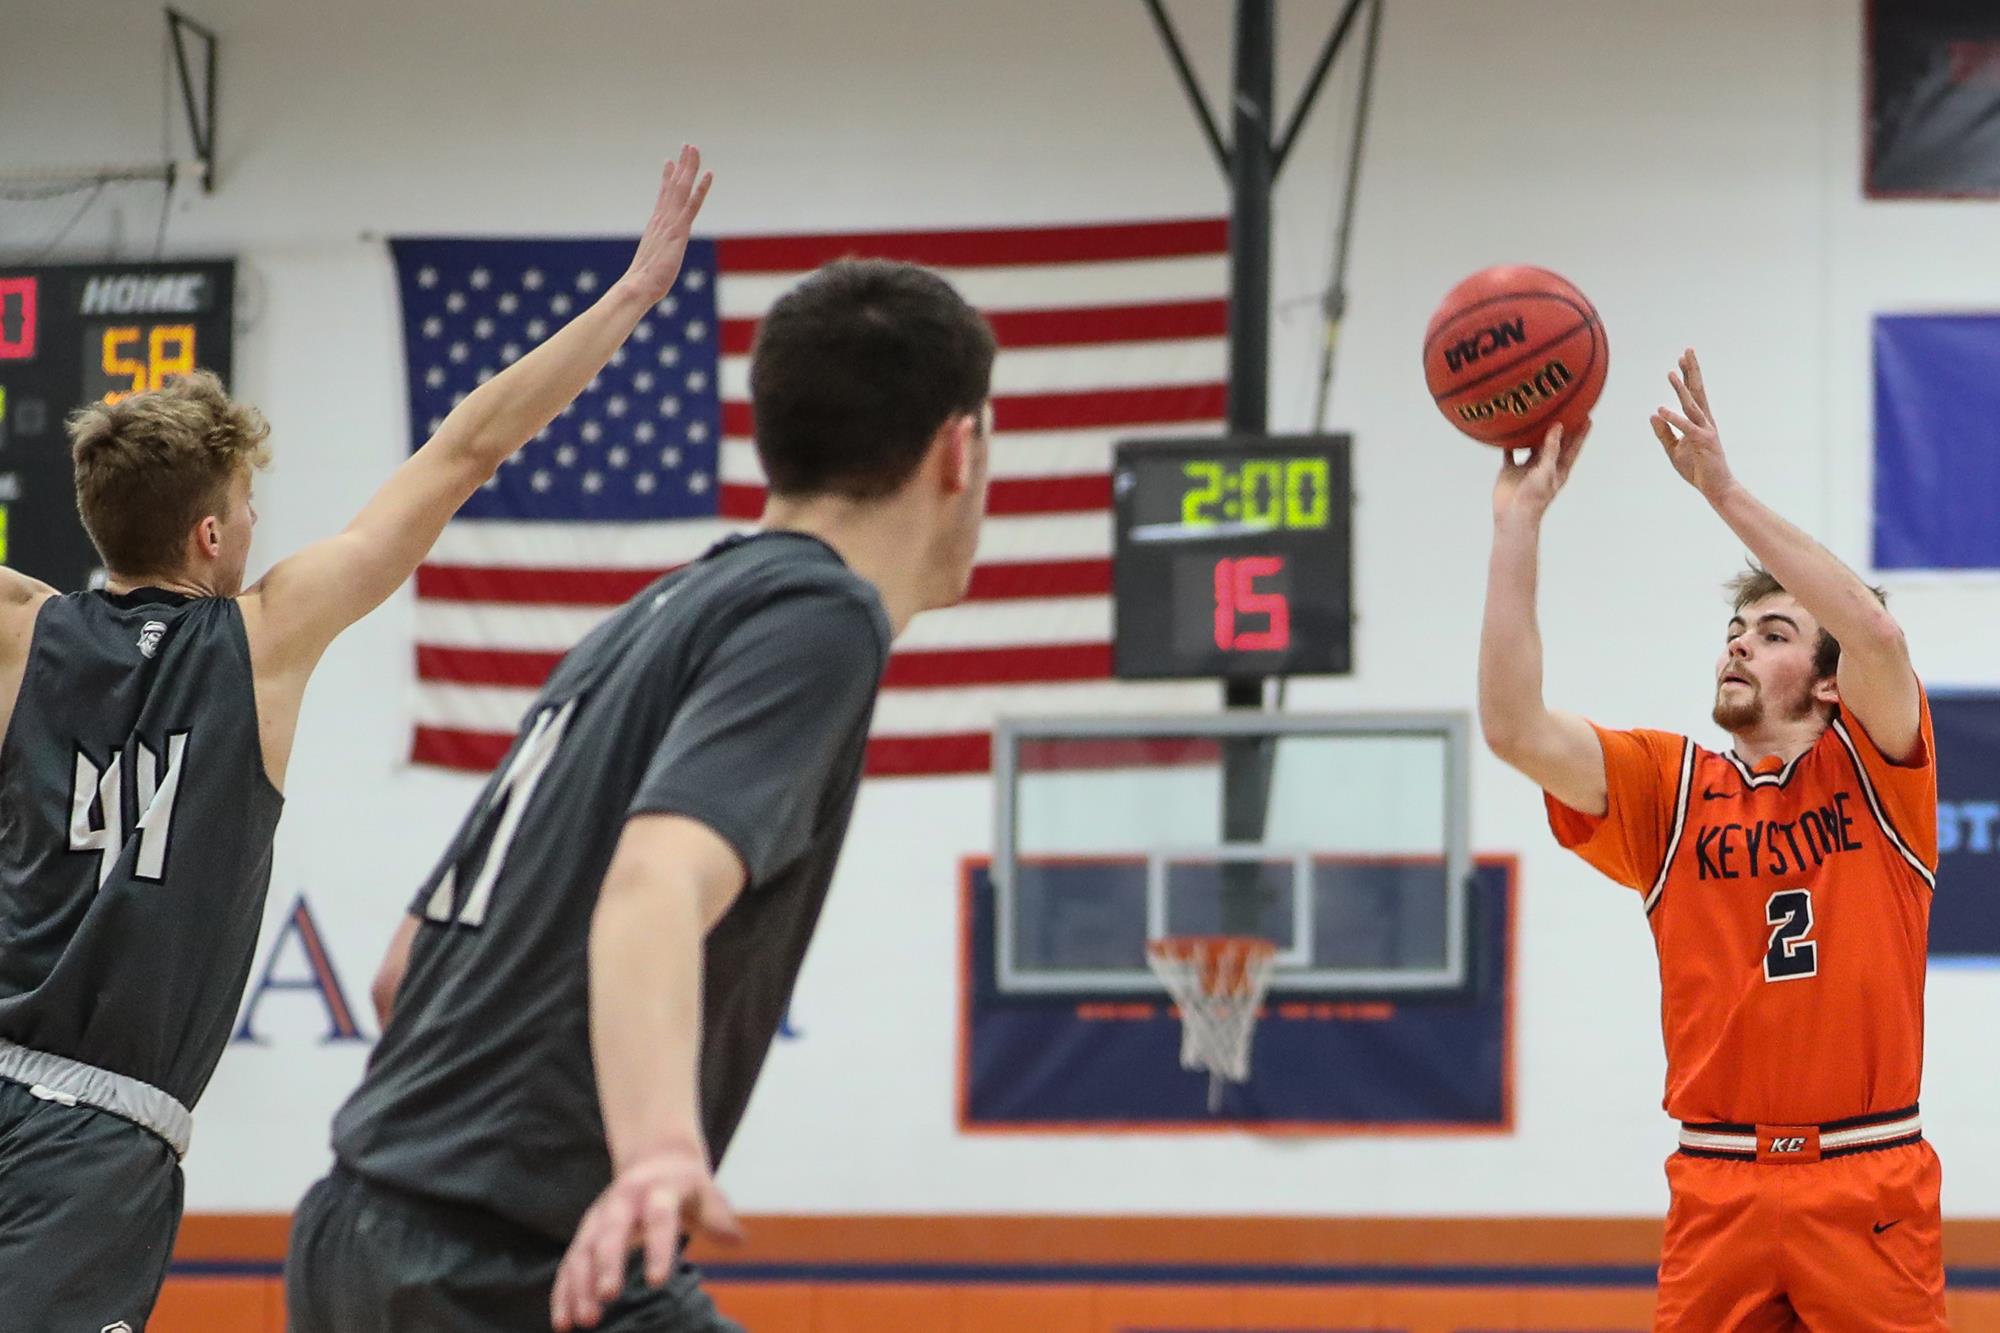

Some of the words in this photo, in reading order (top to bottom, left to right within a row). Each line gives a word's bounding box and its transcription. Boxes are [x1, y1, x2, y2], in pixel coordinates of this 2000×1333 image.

[80, 272, 206, 316] HOME
[1443, 315, 1526, 374] NCAA
[1454, 357, 1574, 423] Wilson
[1181, 456, 1330, 529] 2:00
[1213, 555, 1290, 652] 15
[68, 728, 192, 891] 44
[1695, 791, 1863, 881] KEYSTONE
[1937, 801, 2000, 853] ST
[1762, 887, 1818, 984] 2
